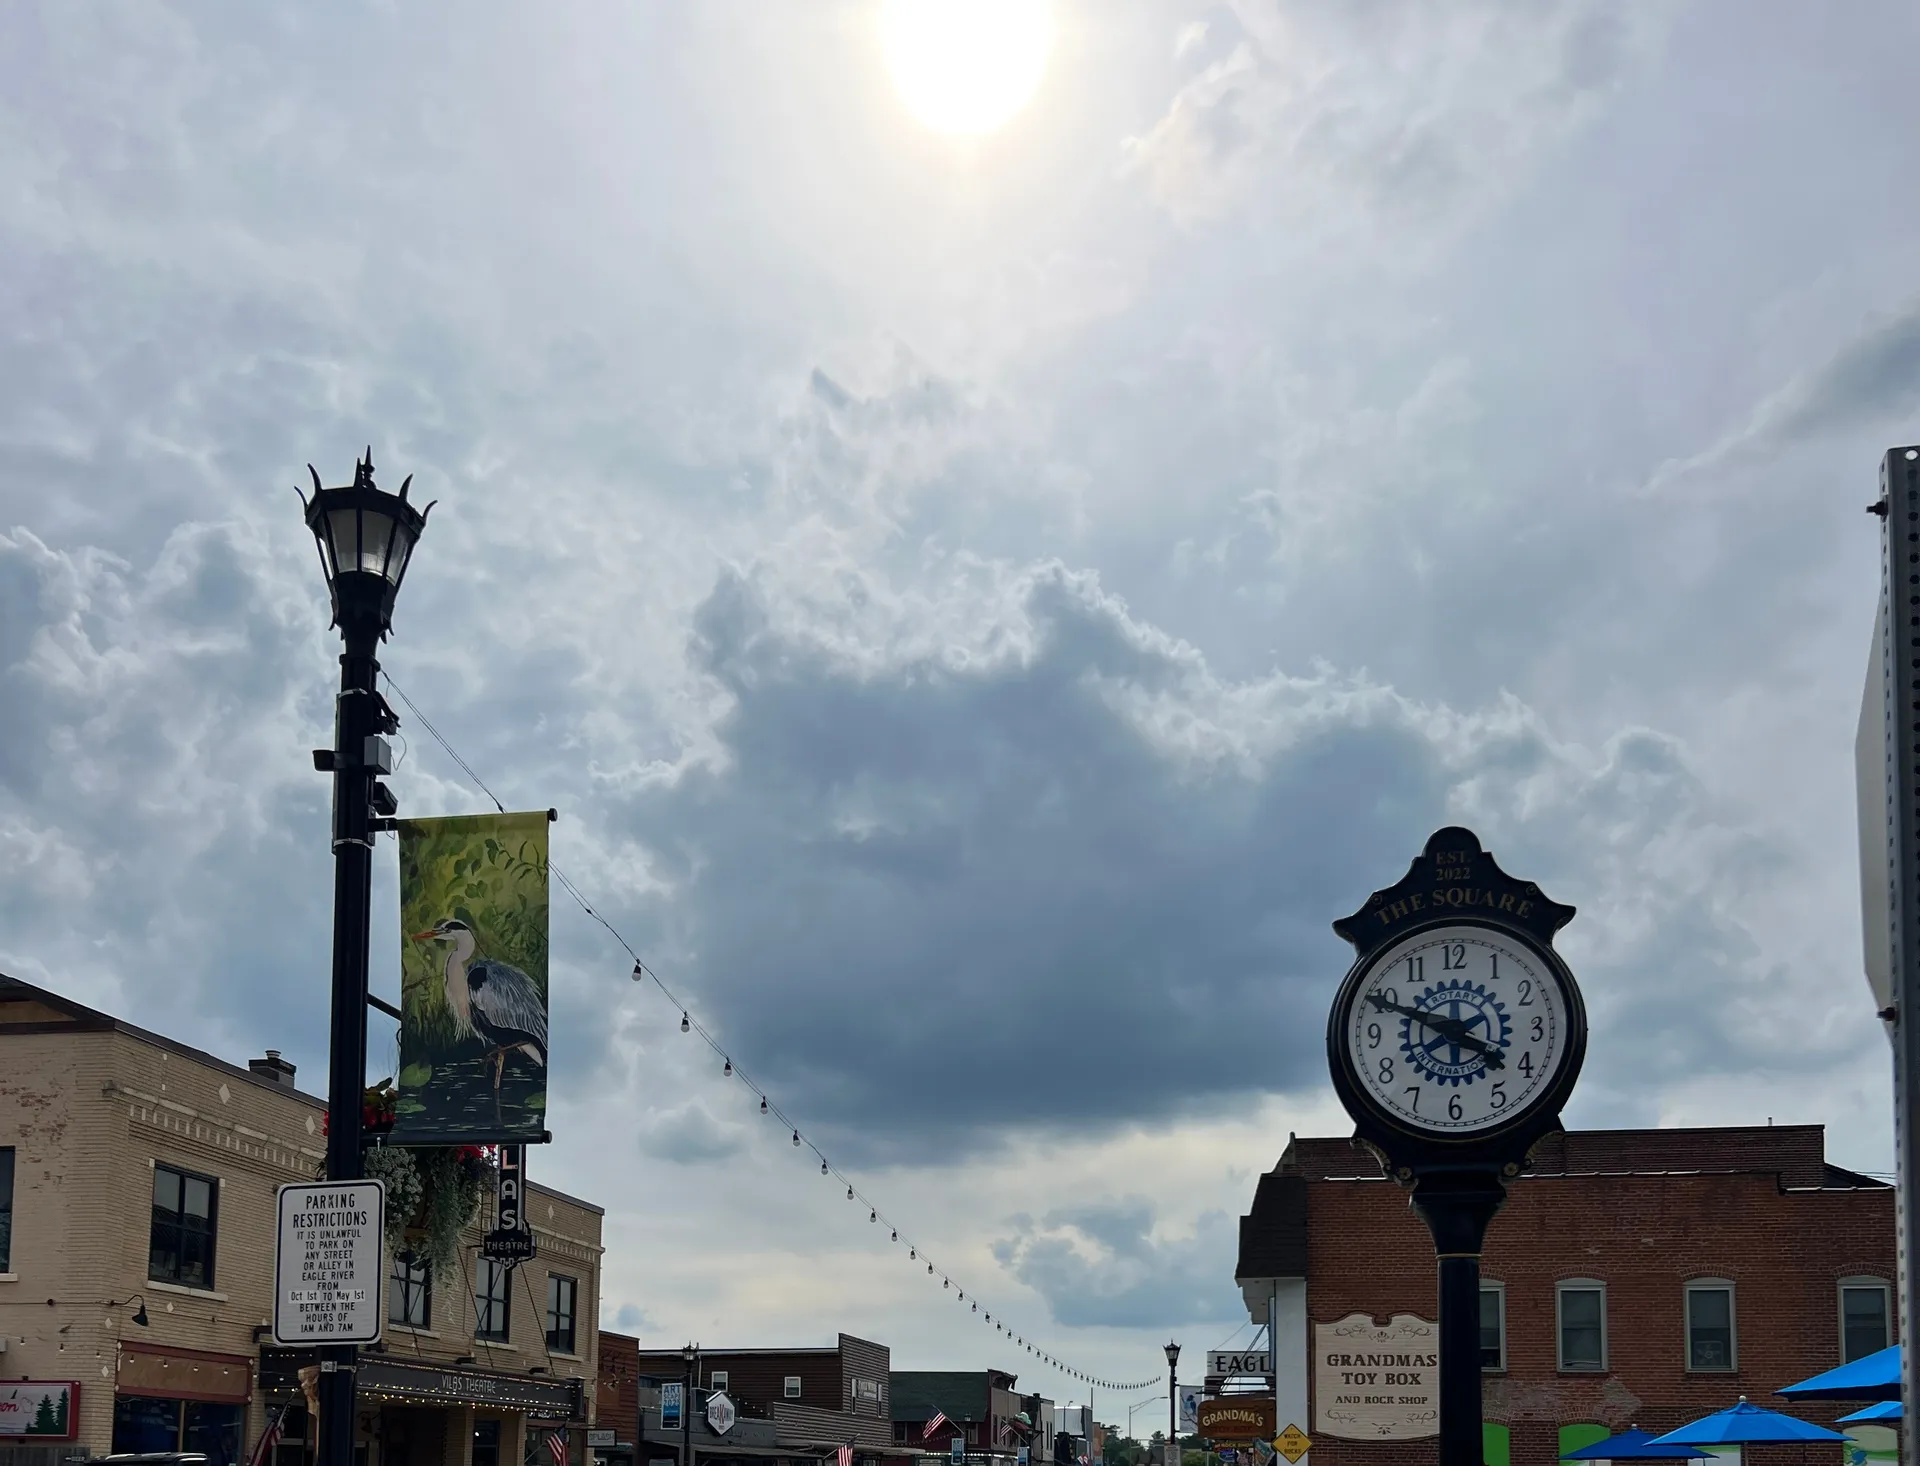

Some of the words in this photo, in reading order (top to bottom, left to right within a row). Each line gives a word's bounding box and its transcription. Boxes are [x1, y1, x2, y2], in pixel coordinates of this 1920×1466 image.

[1436, 867, 1471, 881] 2022
[1374, 892, 1426, 927] THE
[1432, 887, 1534, 919] SQUARE
[1442, 944, 1468, 971] 12
[1406, 956, 1427, 983] 11
[1489, 953, 1501, 980] 1
[1374, 988, 1398, 1014] 10
[1431, 991, 1478, 1004] ROTARY
[1517, 980, 1535, 1007] 2
[1368, 1023, 1382, 1049] 9
[1531, 1016, 1544, 1042] 3
[1378, 1057, 1394, 1084] 8
[1416, 1051, 1486, 1075] INTERNATION
[1517, 1051, 1535, 1079] 4
[1403, 1086, 1420, 1113] 7
[1490, 1080, 1506, 1109] 5
[1448, 1094, 1463, 1121] 6
[500, 1149, 518, 1230] LAS
[306, 1194, 355, 1210] PARKING
[293, 1211, 367, 1228] RESTRICTIONS
[297, 1231, 304, 1240] IT
[308, 1231, 316, 1240] IS
[320, 1230, 362, 1239] UNLAWFUL
[305, 1241, 314, 1250] TO
[319, 1240, 338, 1249] PARK
[342, 1240, 354, 1248] ON
[485, 1240, 530, 1252] THEATRE
[305, 1251, 320, 1260] ANY
[324, 1250, 353, 1260] STREET
[304, 1262, 314, 1270] OR
[318, 1261, 342, 1270] ALLEY
[346, 1260, 354, 1269] IN
[302, 1272, 326, 1281] EAGLE
[331, 1271, 354, 1280] RIVER
[317, 1282, 339, 1290] FROM
[291, 1292, 302, 1301] Oct
[323, 1292, 332, 1301] TO
[336, 1291, 349, 1301] May
[300, 1303, 336, 1312] BETWEEN
[340, 1302, 355, 1311] THE
[306, 1313, 333, 1322] HOURS
[338, 1313, 348, 1322] OF
[301, 1324, 314, 1333] 1AM
[318, 1323, 334, 1332] AND
[338, 1323, 353, 1332] 7AM
[1215, 1355, 1269, 1372] EAGL
[1326, 1354, 1437, 1367] GRANDMAS
[442, 1374, 463, 1392] VILAS
[466, 1377, 496, 1394] THEATRE
[1341, 1372, 1378, 1385] TOY
[1384, 1373, 1422, 1385] BOX
[664, 1385, 680, 1393] ART
[1335, 1396, 1360, 1404] AND
[1364, 1396, 1394, 1404] ROCK
[1398, 1396, 1428, 1404] SHOP
[1202, 1409, 1264, 1427] GRANDMA'S
